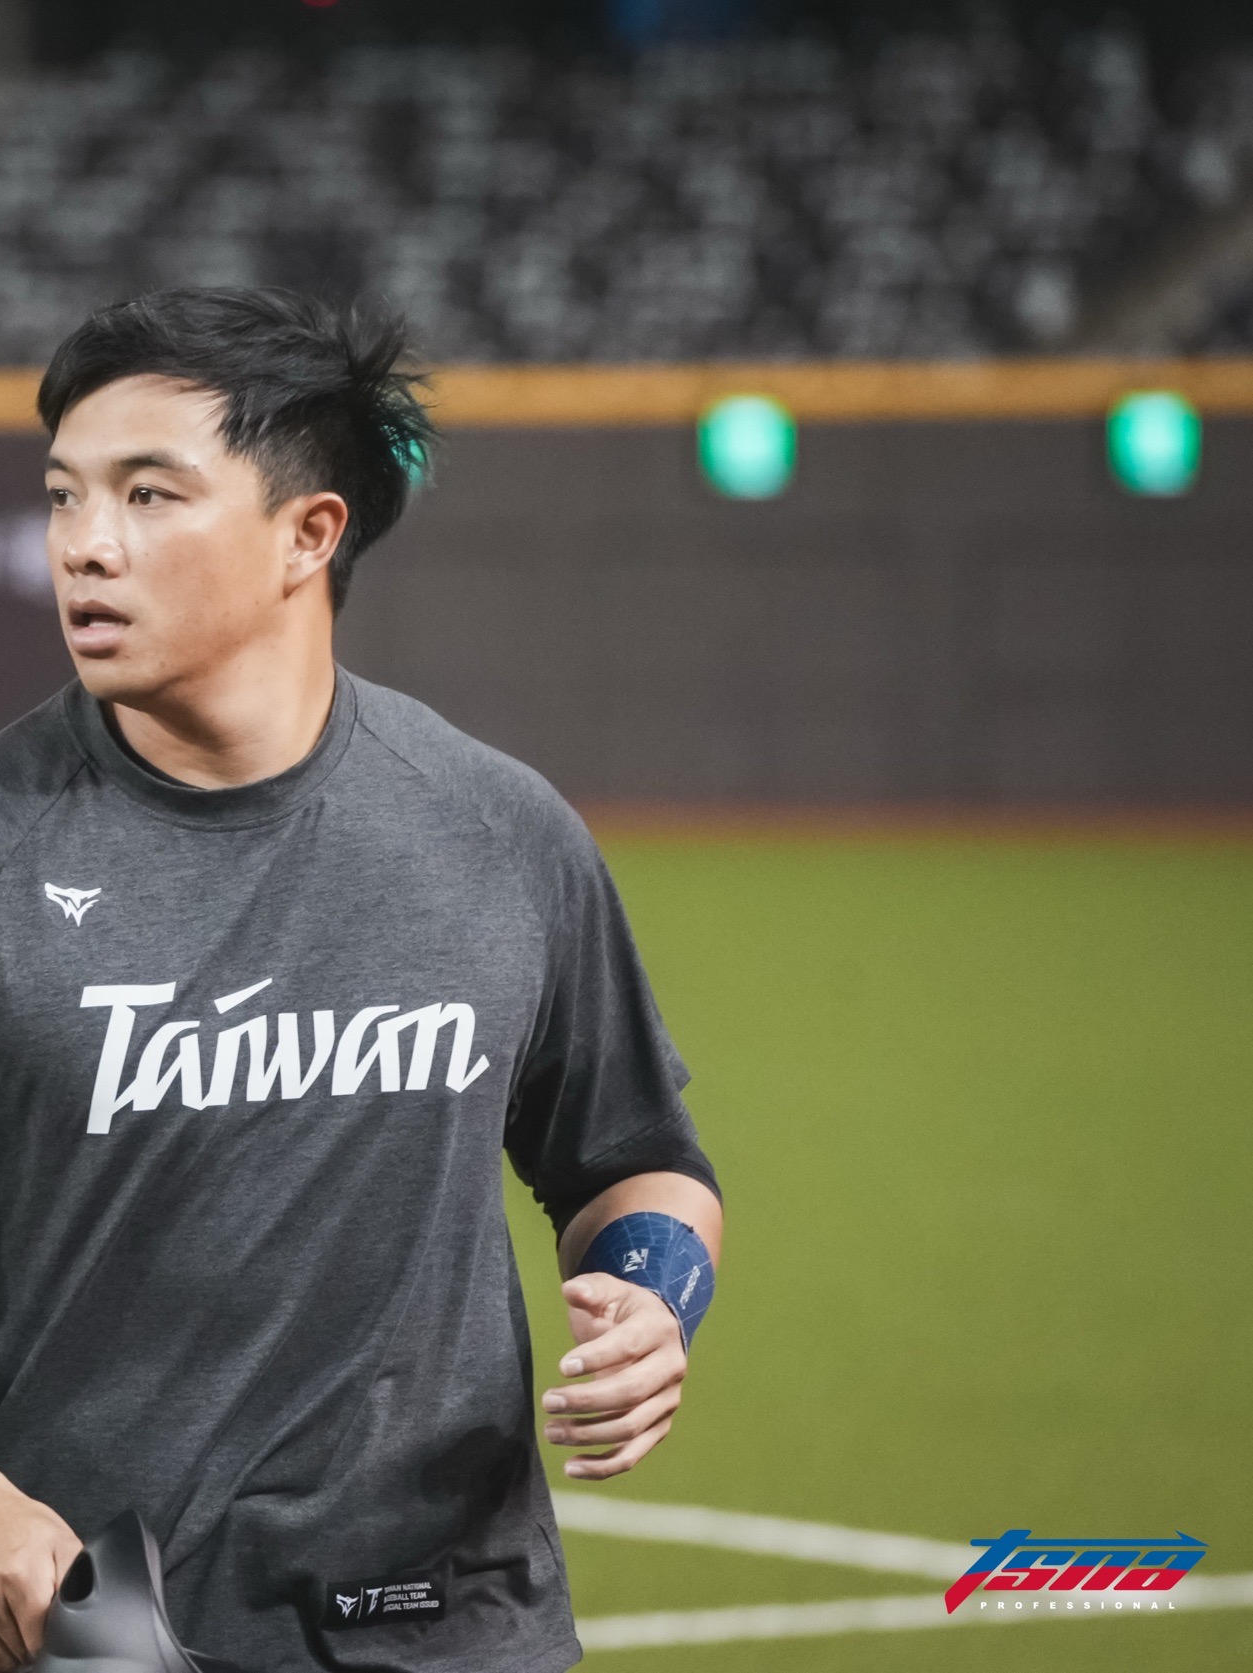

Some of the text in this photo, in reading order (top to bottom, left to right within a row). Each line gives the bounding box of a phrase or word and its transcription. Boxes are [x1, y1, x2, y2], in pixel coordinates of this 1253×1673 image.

[80, 978, 490, 1134] Taiwan
[402, 1582, 432, 1591] NATIONAL
[409, 1591, 427, 1600] TEAM
[402, 1601, 419, 1610] TEAM
